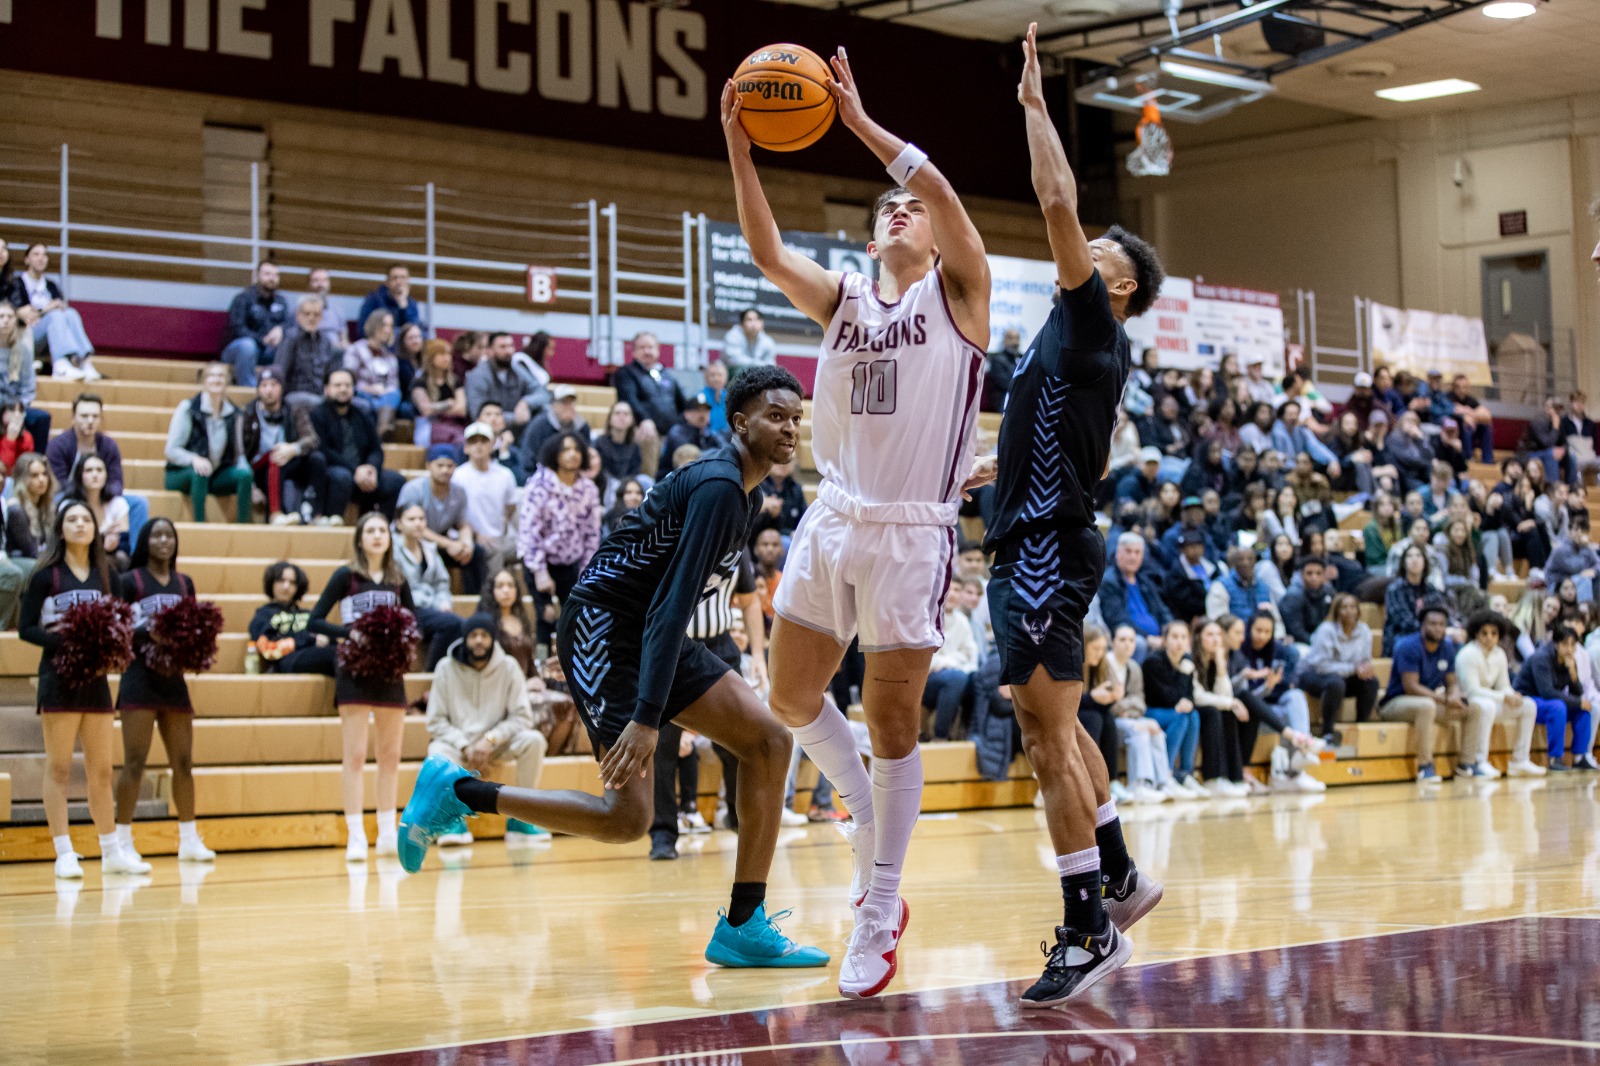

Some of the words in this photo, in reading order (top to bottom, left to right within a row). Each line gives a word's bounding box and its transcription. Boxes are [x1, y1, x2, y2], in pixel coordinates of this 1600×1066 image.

[308, 0, 708, 120] FALCONS
[738, 81, 803, 100] Wilson
[532, 273, 552, 303] B
[832, 315, 926, 352] FALCONS
[851, 359, 897, 415] 10
